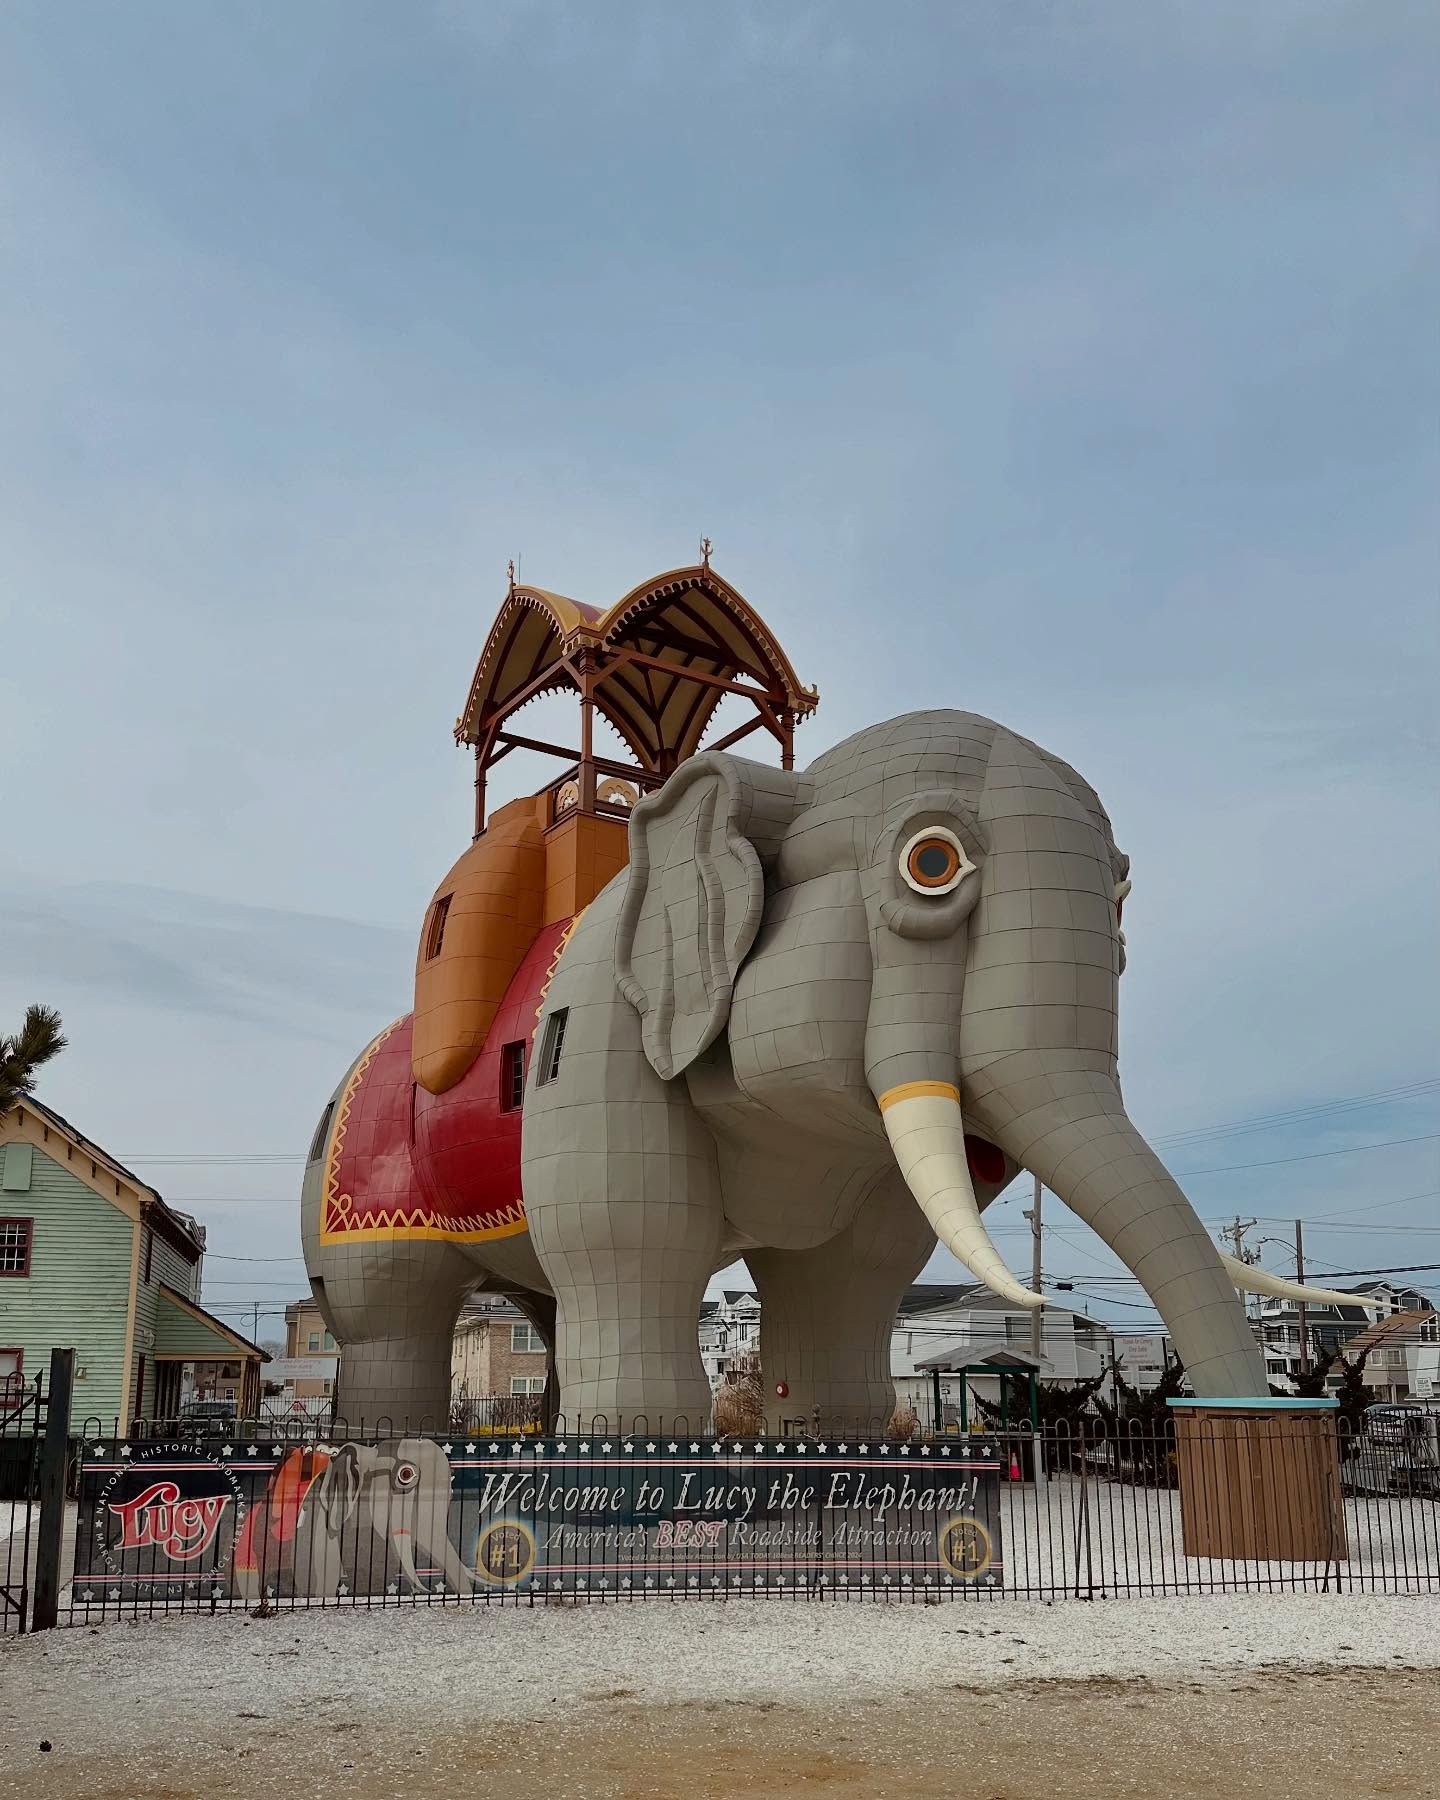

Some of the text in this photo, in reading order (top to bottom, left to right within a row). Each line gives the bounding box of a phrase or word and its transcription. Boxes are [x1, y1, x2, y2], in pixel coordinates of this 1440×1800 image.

[96, 1444, 246, 1514] NATIONAL HISTORIC LANDMARK
[478, 1472, 979, 1522] Welcome to Lucy the Elephant!
[107, 1481, 232, 1561] Lucy
[541, 1518, 933, 1549] America's BEST Roadside Attraction
[96, 1532, 182, 1595] MARGATE CITY, NJ
[201, 1524, 245, 1583] SINCE 1881
[490, 1544, 521, 1568] #1
[952, 1540, 980, 1562] #1
